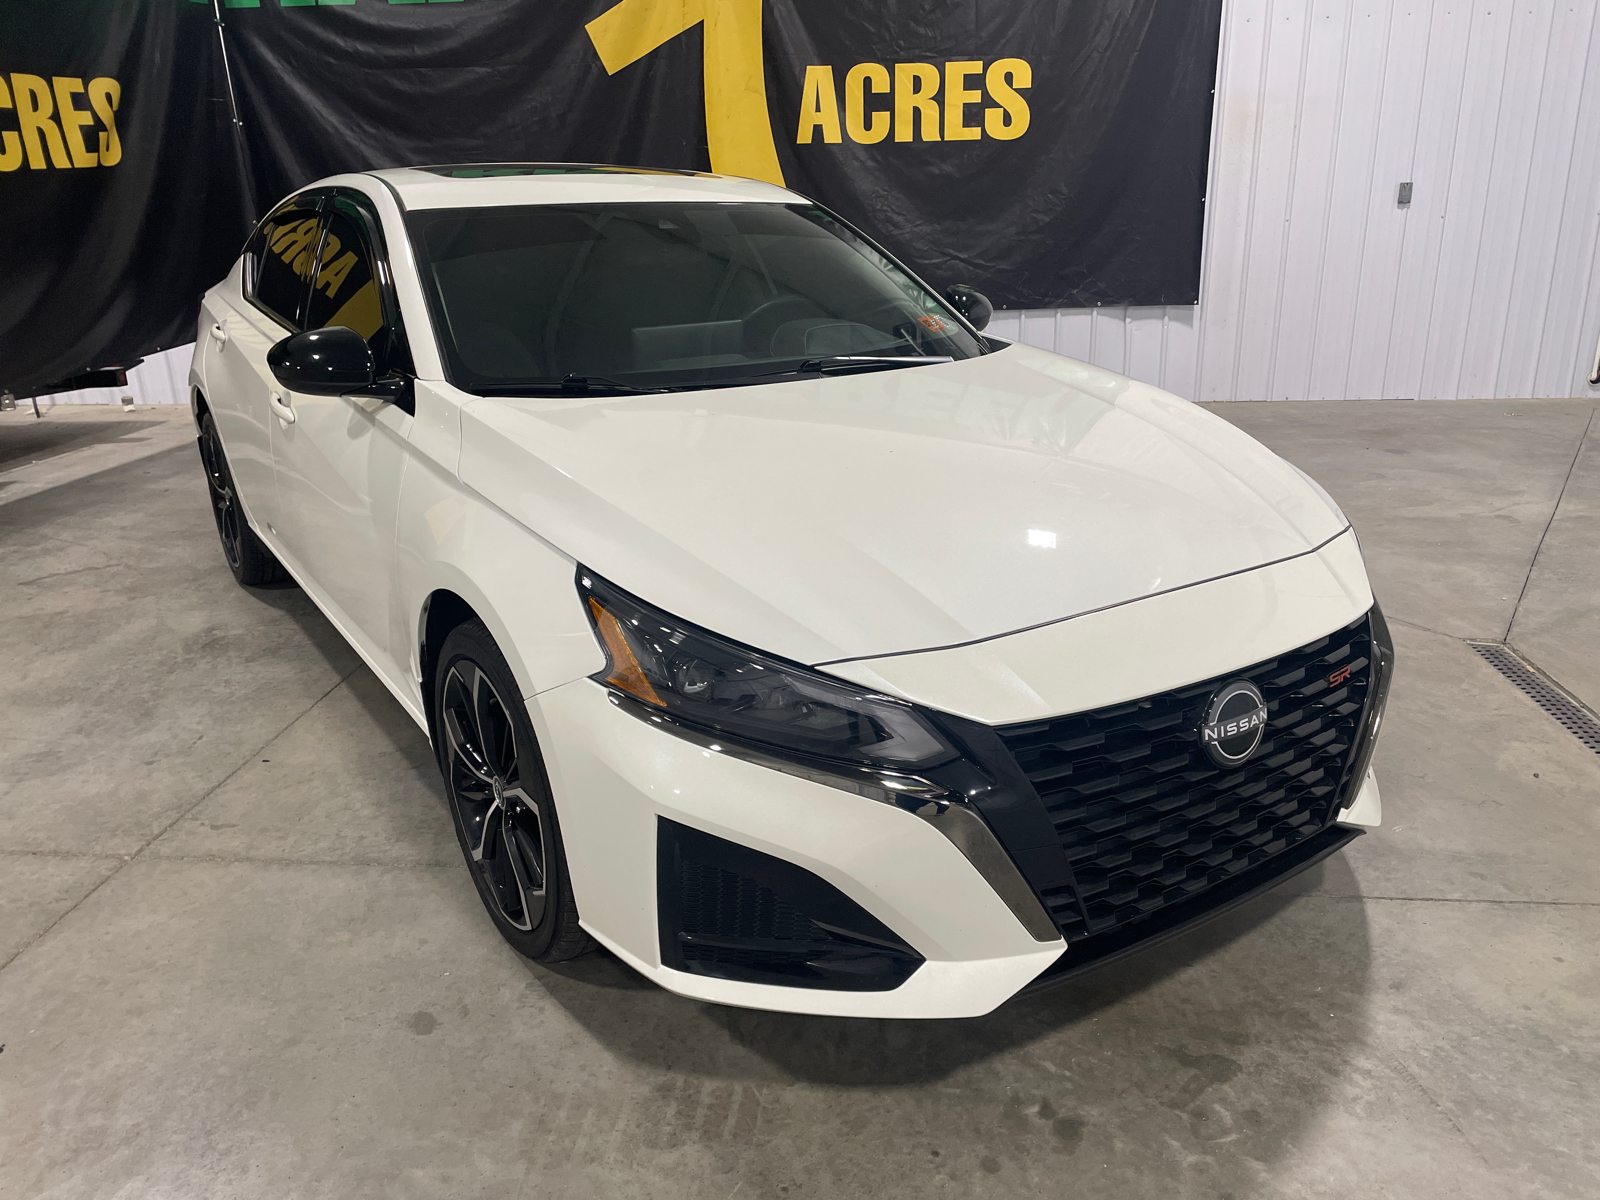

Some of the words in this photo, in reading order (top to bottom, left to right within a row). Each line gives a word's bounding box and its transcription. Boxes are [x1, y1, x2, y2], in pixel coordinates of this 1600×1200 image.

[796, 58, 1032, 145] ACRES
[1329, 665, 1351, 688] SR
[1204, 707, 1267, 741] NISSAN
